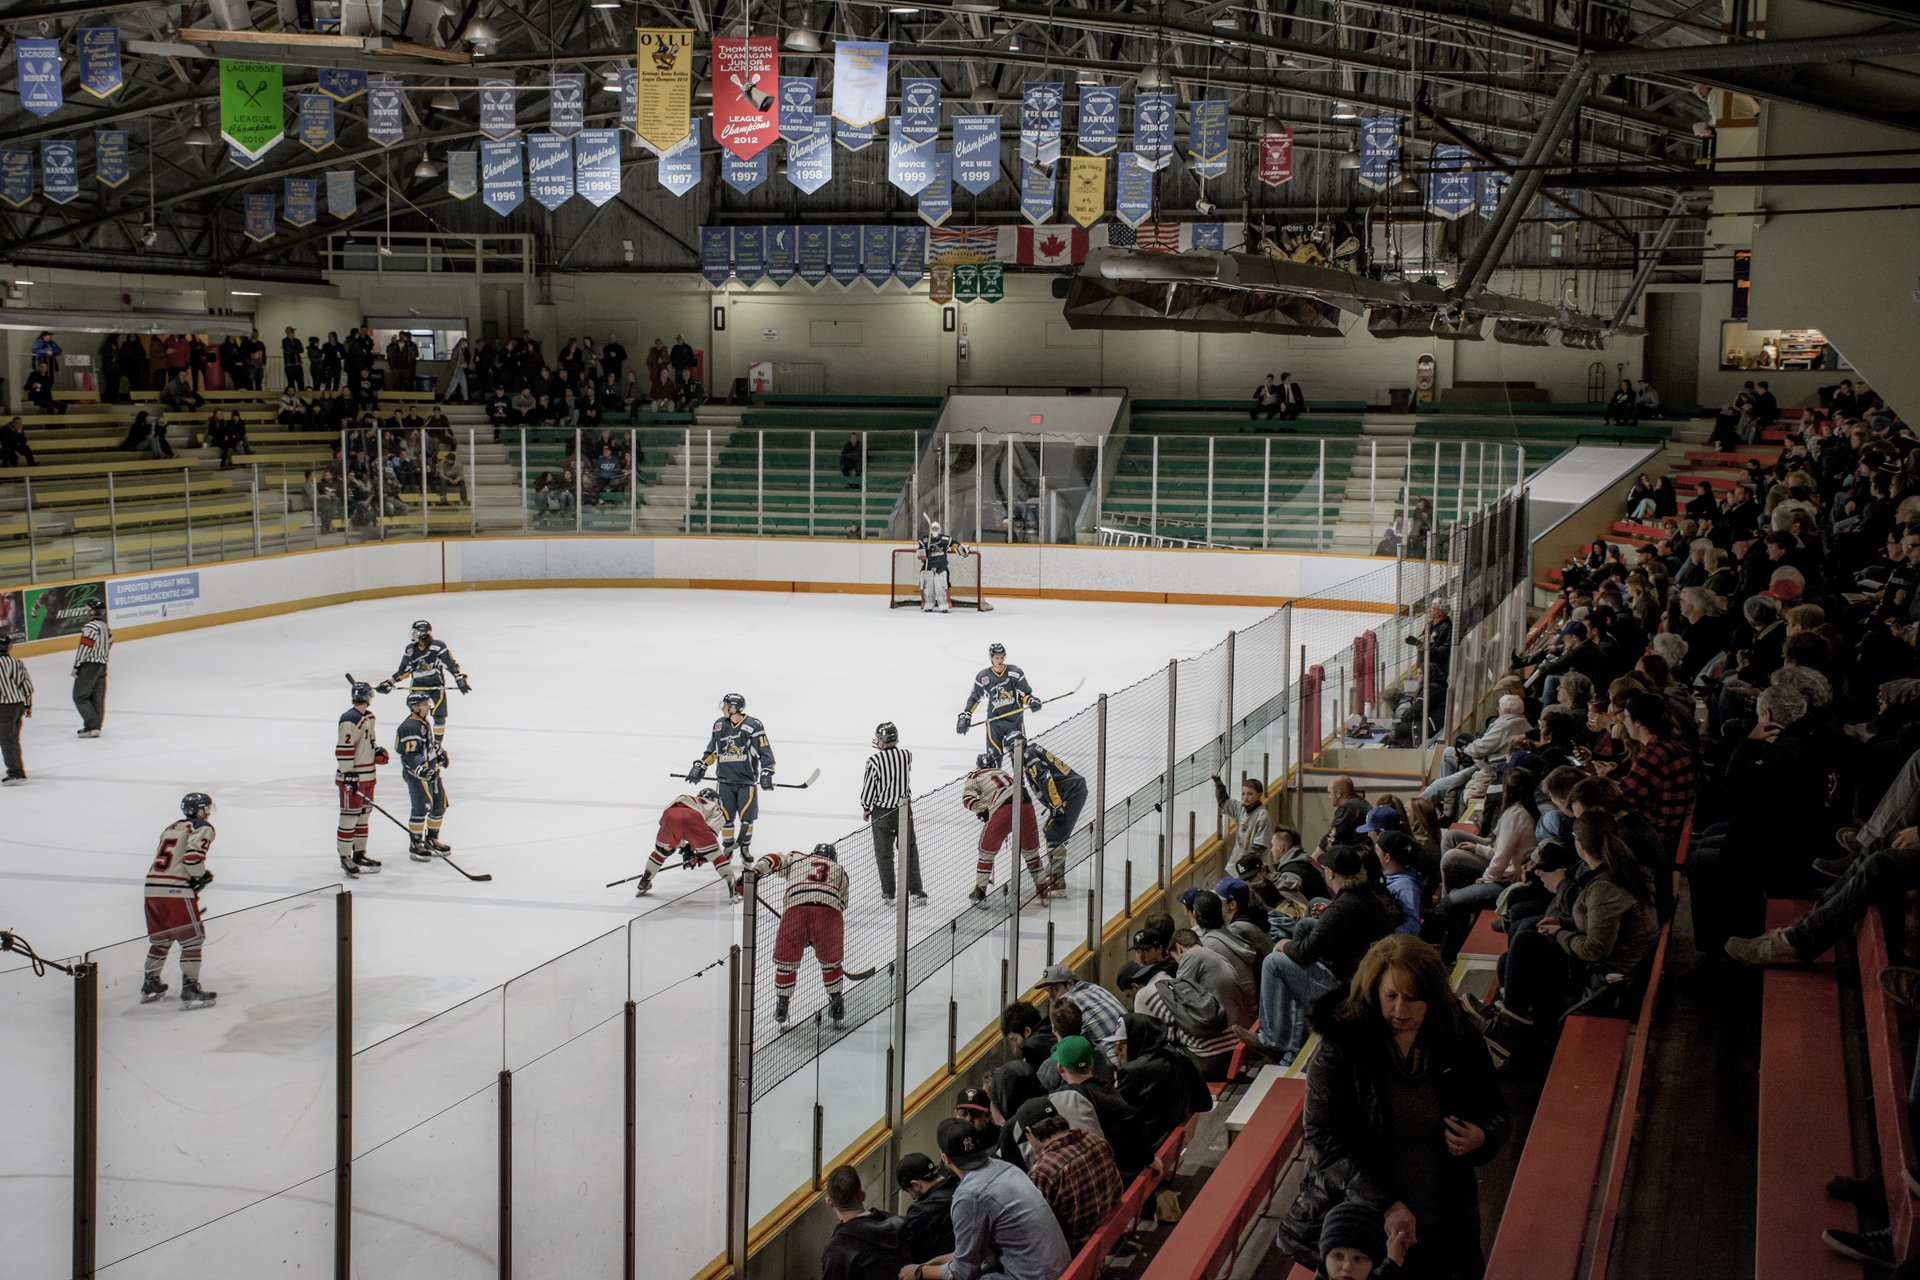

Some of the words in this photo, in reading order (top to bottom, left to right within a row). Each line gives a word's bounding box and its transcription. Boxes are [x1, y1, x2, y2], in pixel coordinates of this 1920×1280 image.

[641, 34, 690, 46] OXLL
[226, 65, 277, 73] LACROSSE
[1041, 110, 1058, 118] WEE
[229, 124, 276, 135] Champions
[721, 120, 770, 139] Champions
[241, 136, 265, 144] 2010
[837, 131, 872, 139] CHAMPIONS
[789, 134, 829, 161] Champions
[955, 130, 998, 158] Champions
[529, 149, 569, 174] Champions
[577, 145, 617, 168] Champions
[483, 154, 519, 180] Champions
[667, 174, 692, 184] 1997
[731, 172, 758, 182] 1997
[796, 170, 823, 180] 1998
[898, 171, 926, 181] 1999
[962, 171, 991, 182] 1999
[484, 181, 522, 189] INTERMEDIATE
[538, 185, 565, 195] 1996
[585, 181, 612, 191] 1996
[491, 191, 516, 202] 1996
[117, 582, 149, 593] EXPEDITED
[150, 579, 175, 589] UPRIGHT
[345, 734, 352, 743] 2
[807, 862, 830, 882] 3
